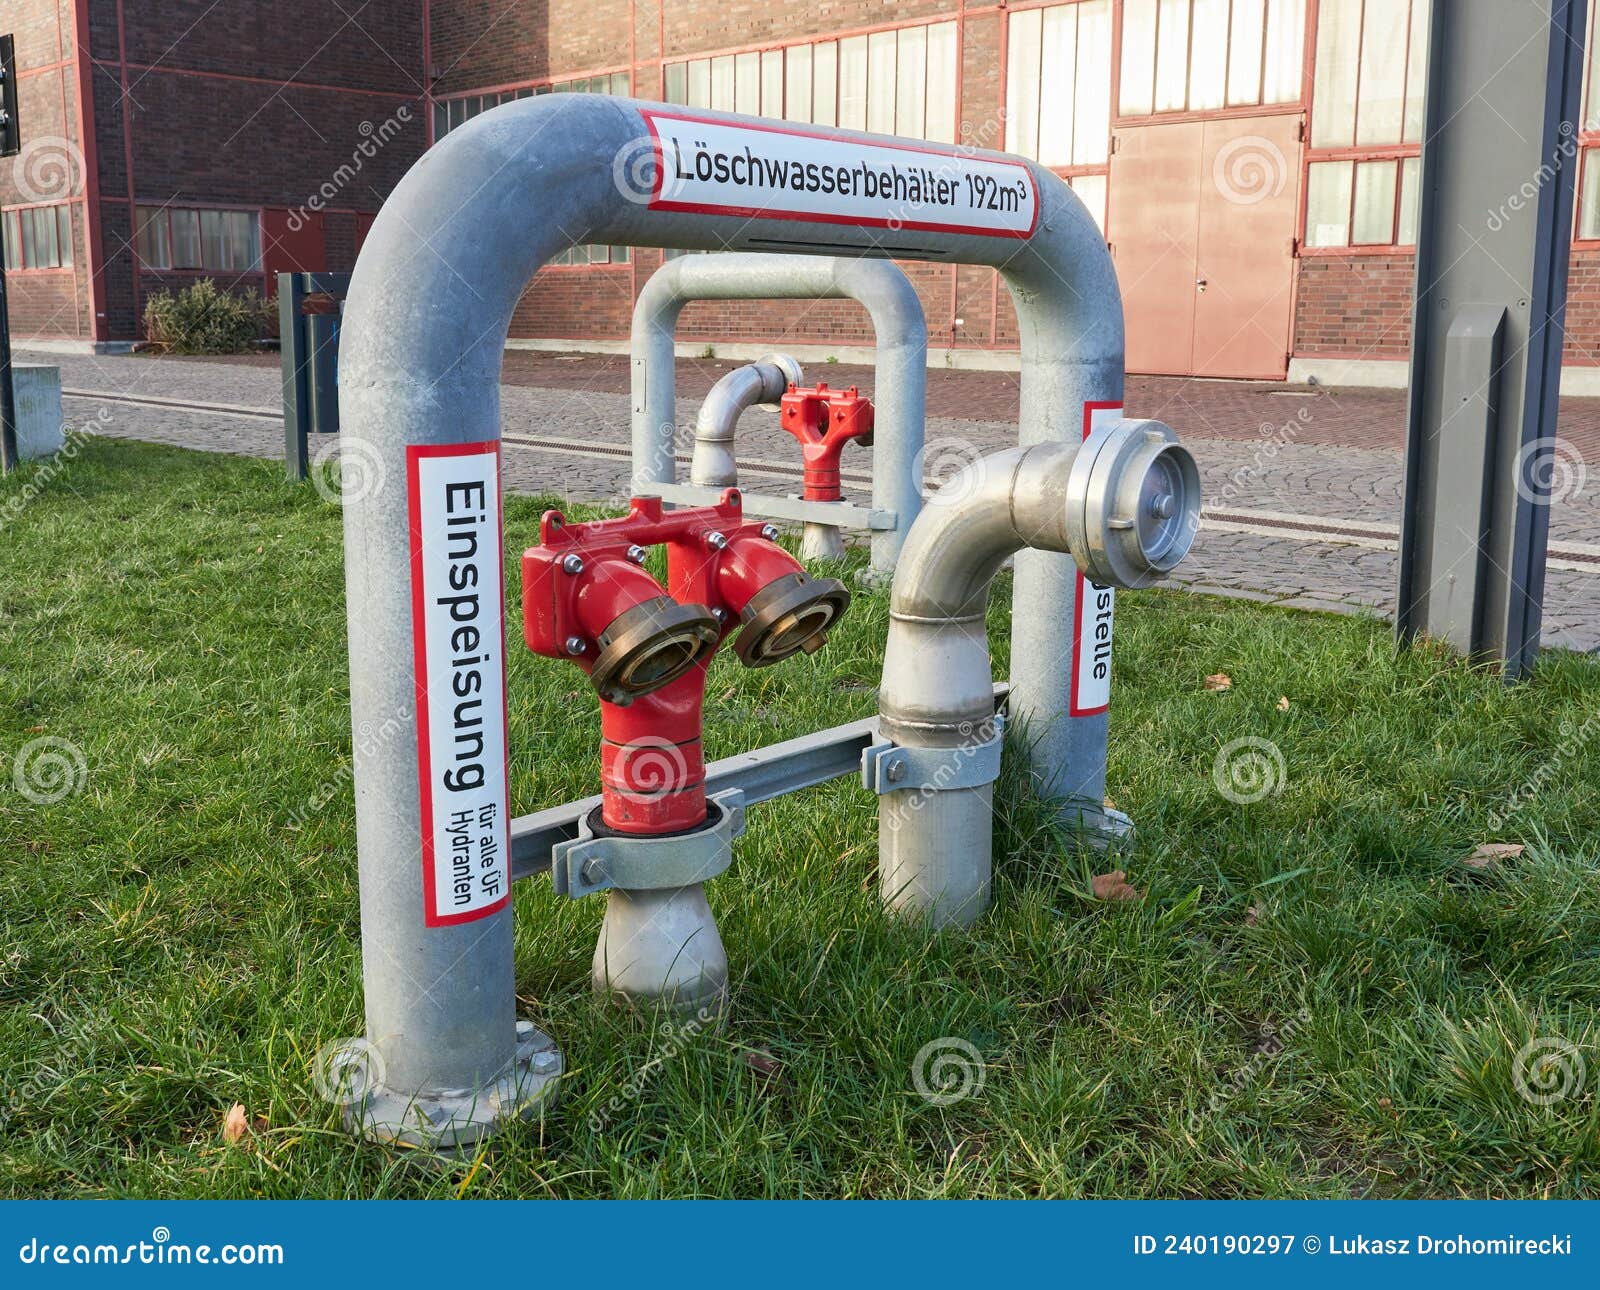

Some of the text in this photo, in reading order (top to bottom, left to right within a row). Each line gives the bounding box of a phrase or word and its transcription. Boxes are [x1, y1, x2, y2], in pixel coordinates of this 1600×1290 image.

[671, 137, 960, 206] Löschwasserbehälter
[437, 481, 490, 792] Einspeisung
[445, 809, 475, 905] Hydranten
[479, 802, 503, 896] für alle ÜF
